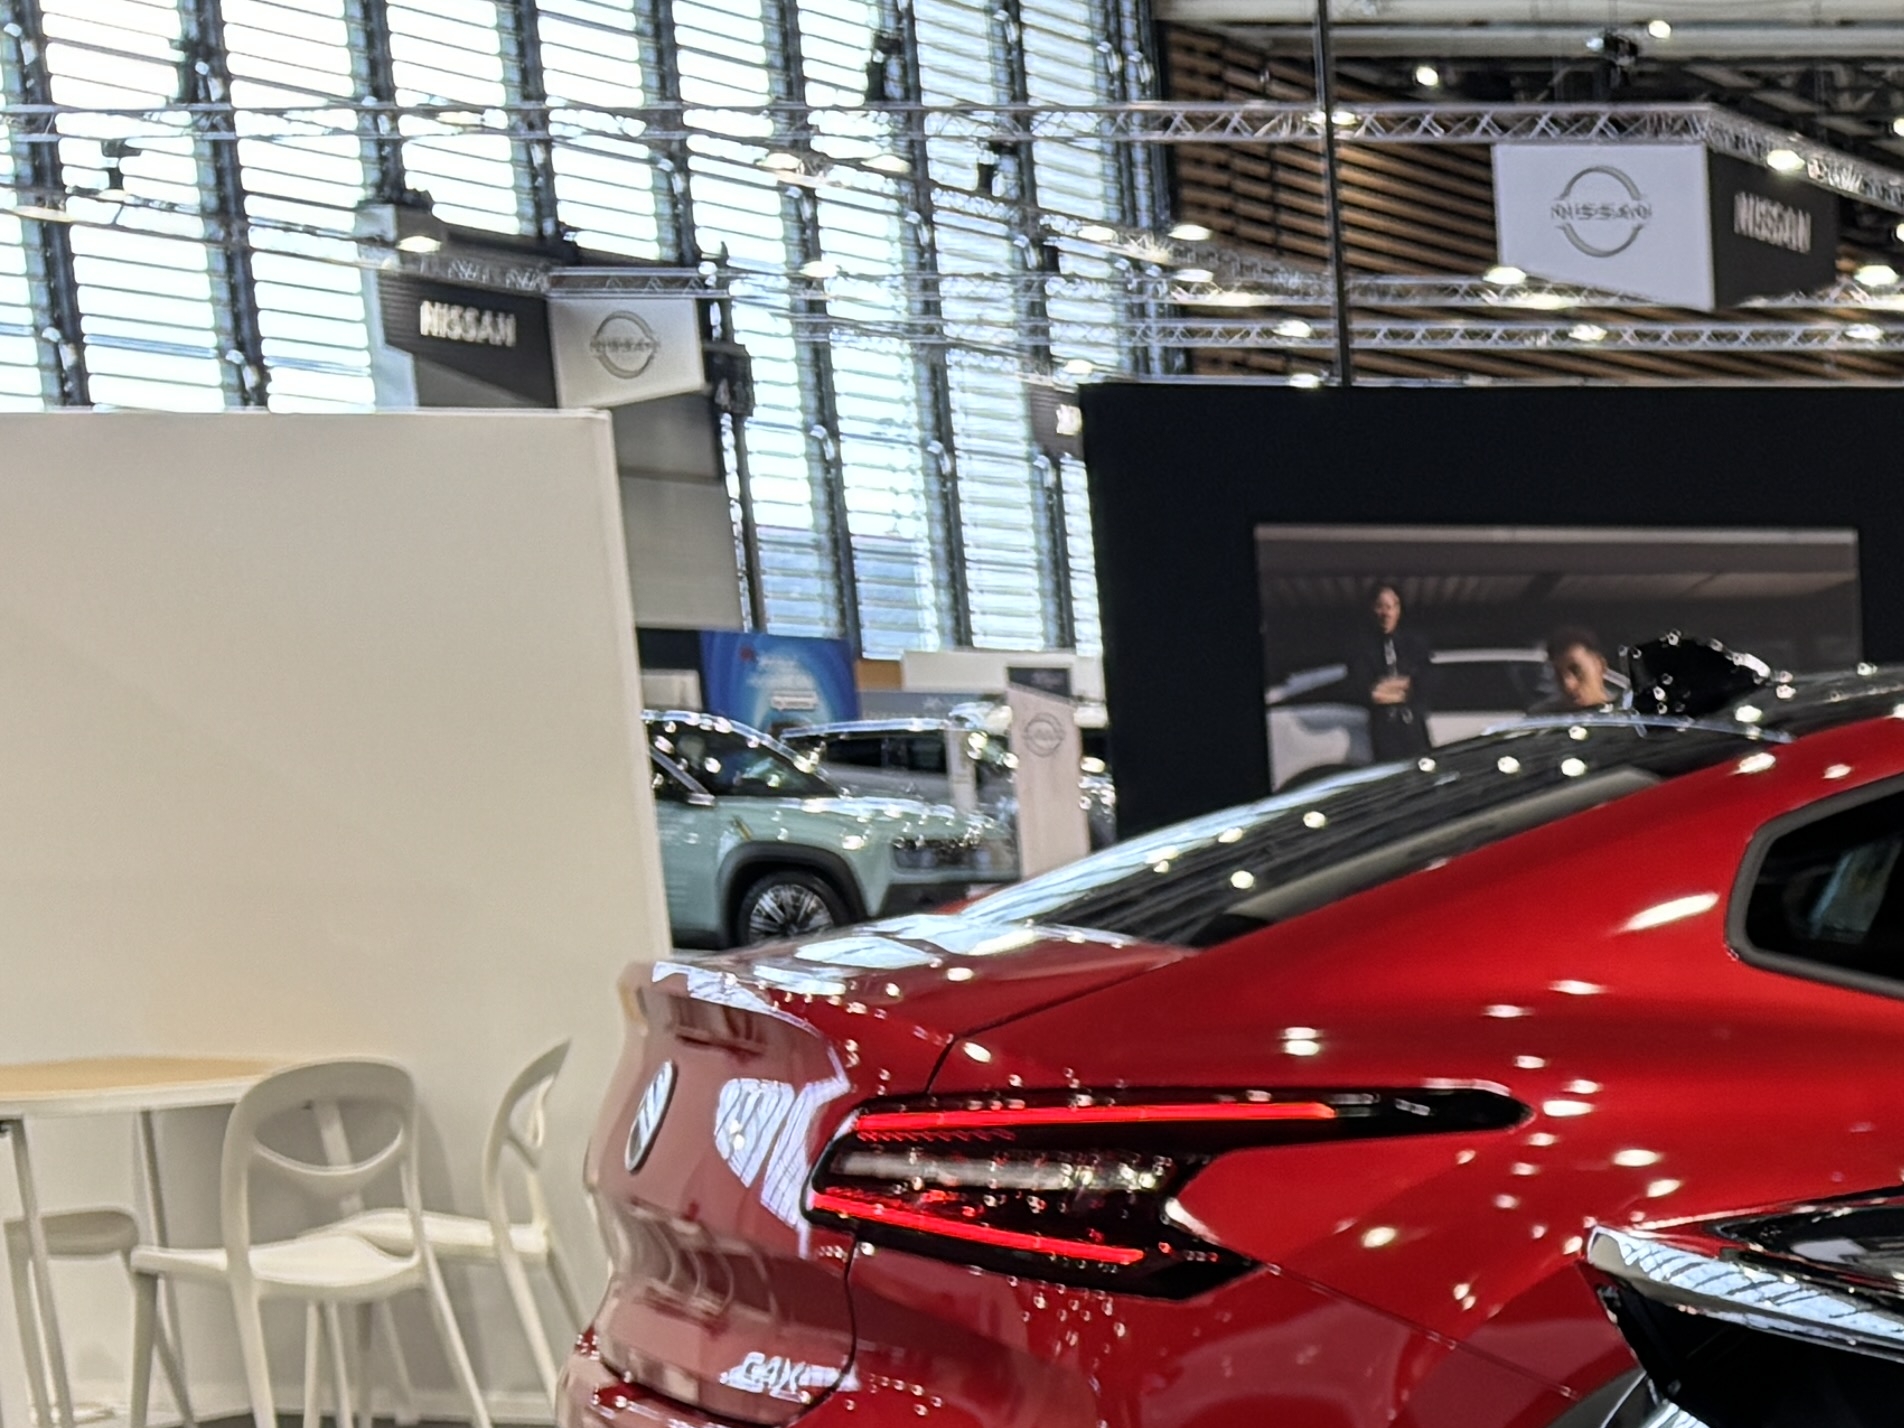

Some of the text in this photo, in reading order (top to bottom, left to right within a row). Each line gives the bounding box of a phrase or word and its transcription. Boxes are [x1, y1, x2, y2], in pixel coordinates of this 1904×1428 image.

[1551, 201, 1652, 222] NISSAN
[1733, 190, 1812, 255] NISSAN
[419, 300, 517, 348] NISSAN
